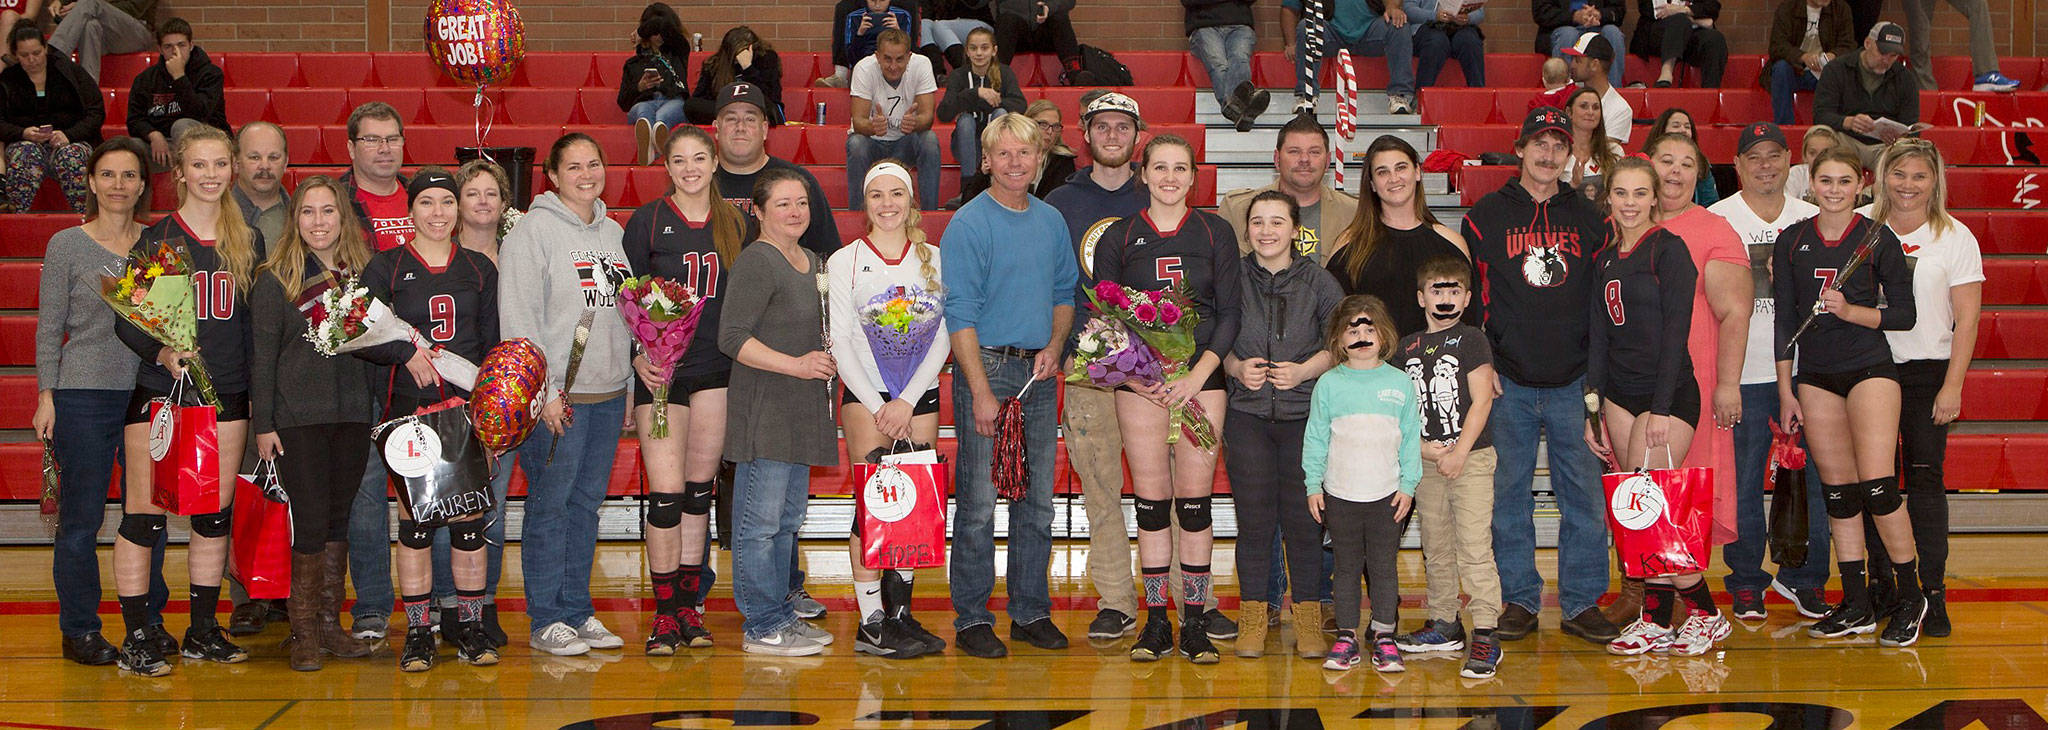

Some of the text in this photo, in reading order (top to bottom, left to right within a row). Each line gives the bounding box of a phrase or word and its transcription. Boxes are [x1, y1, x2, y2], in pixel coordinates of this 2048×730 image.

[438, 14, 486, 41] GREAT
[447, 41, 486, 66] JOB!
[887, 95, 901, 117] 7
[374, 219, 414, 228] OLVE
[1749, 229, 1774, 243] WE
[1506, 230, 1582, 260] WOLVES
[682, 251, 720, 299] 11
[1155, 256, 1184, 294] 5
[190, 270, 236, 321] 10
[1604, 279, 1626, 327] 8
[1814, 268, 1838, 315] 7
[428, 294, 456, 342] 9
[411, 486, 492, 524] LAUREN
[883, 485, 898, 503] H
[1628, 492, 1646, 512] K
[878, 544, 930, 567] HOPE
